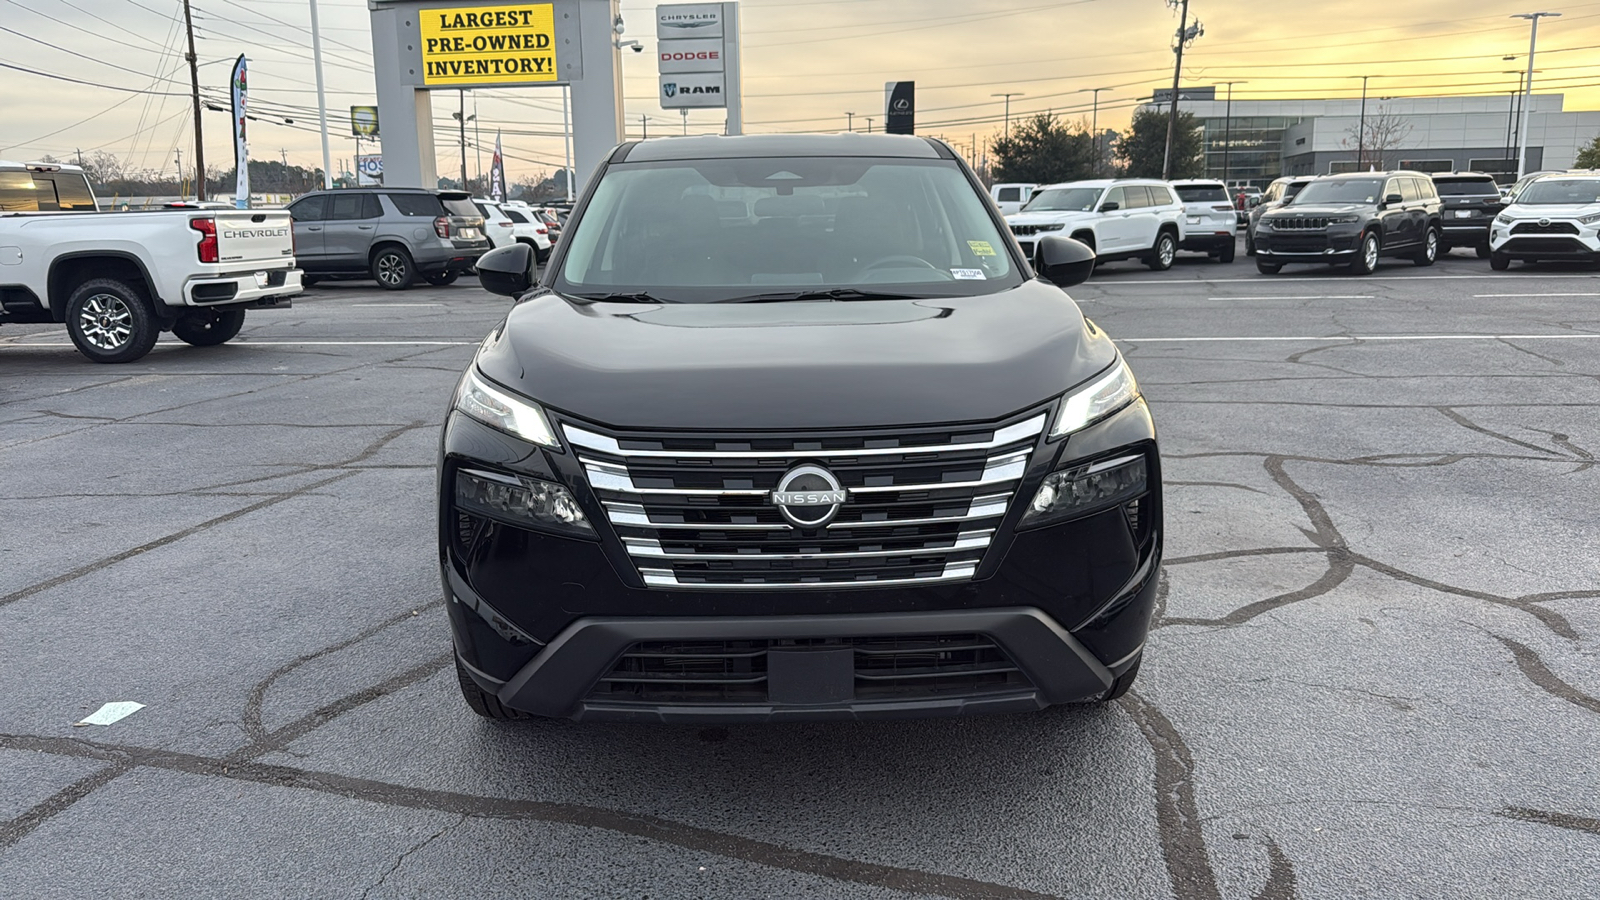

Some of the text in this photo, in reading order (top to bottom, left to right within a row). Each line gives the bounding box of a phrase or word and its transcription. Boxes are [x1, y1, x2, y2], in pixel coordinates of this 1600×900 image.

[440, 10, 533, 29] LARGEST
[426, 33, 550, 53] PRE-OWNED
[661, 51, 719, 61] DODGE
[426, 57, 552, 76] INVENTORY!
[680, 86, 720, 94] RAM
[224, 229, 288, 239] CHEVROLET
[774, 493, 844, 504] NISSAN
